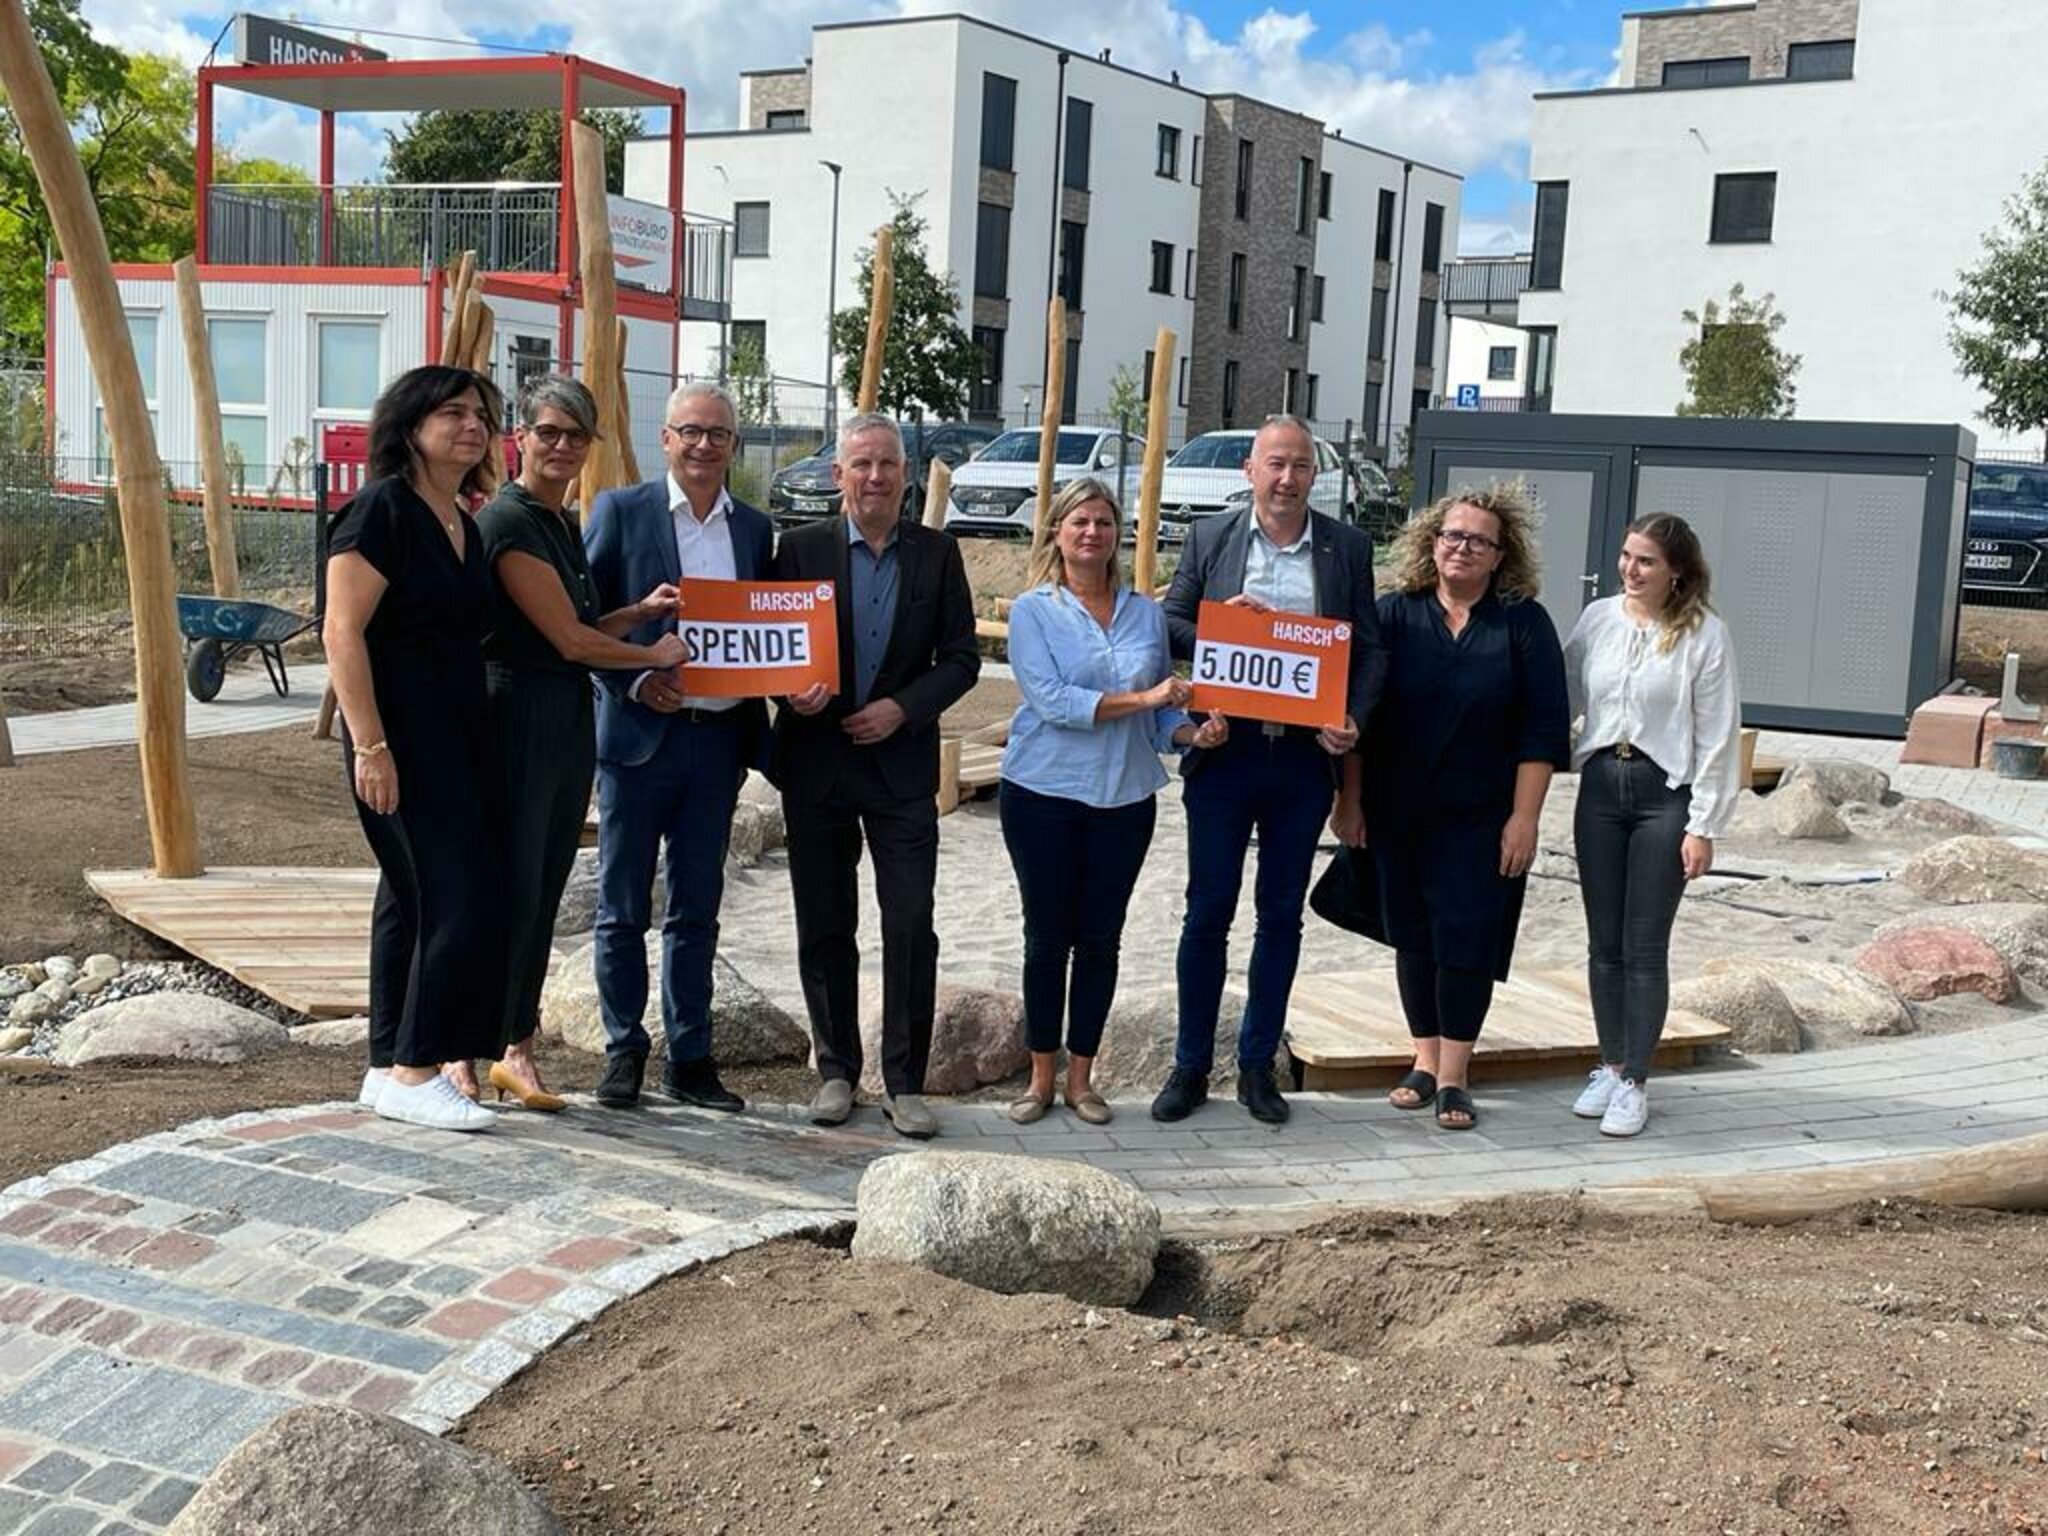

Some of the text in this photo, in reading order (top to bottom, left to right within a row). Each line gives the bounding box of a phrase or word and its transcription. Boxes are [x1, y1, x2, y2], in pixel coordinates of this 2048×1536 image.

[750, 591, 815, 611] HARSCH
[684, 627, 806, 663] SPENDE
[1272, 620, 1333, 647] HARSCH
[1200, 647, 1313, 694] 5.000 €
